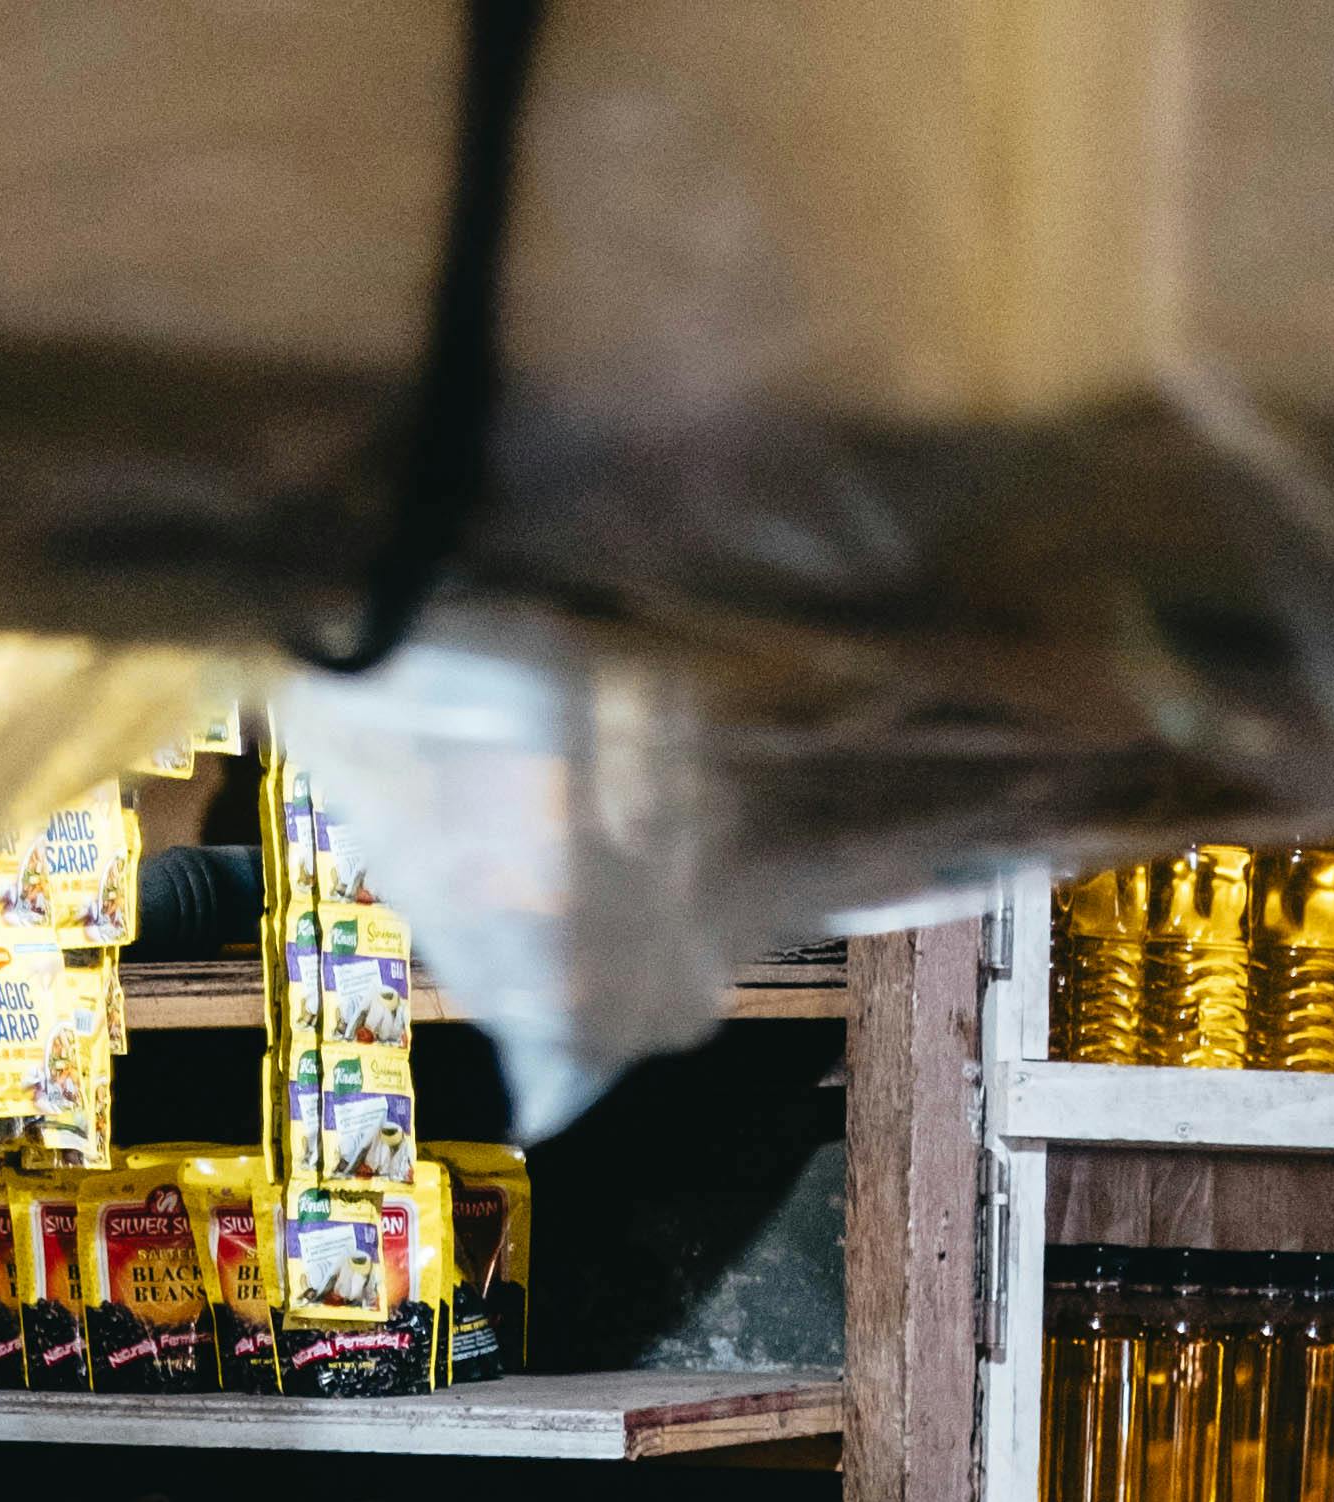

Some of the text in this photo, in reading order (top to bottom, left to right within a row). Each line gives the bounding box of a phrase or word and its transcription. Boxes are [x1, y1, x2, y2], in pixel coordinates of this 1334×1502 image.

[46, 810, 95, 842] MAGIC
[45, 843, 98, 874] SARAP
[111, 1215, 168, 1236] SILVER
[223, 1213, 255, 1235] SILV
[134, 1284, 206, 1303] BEANS
